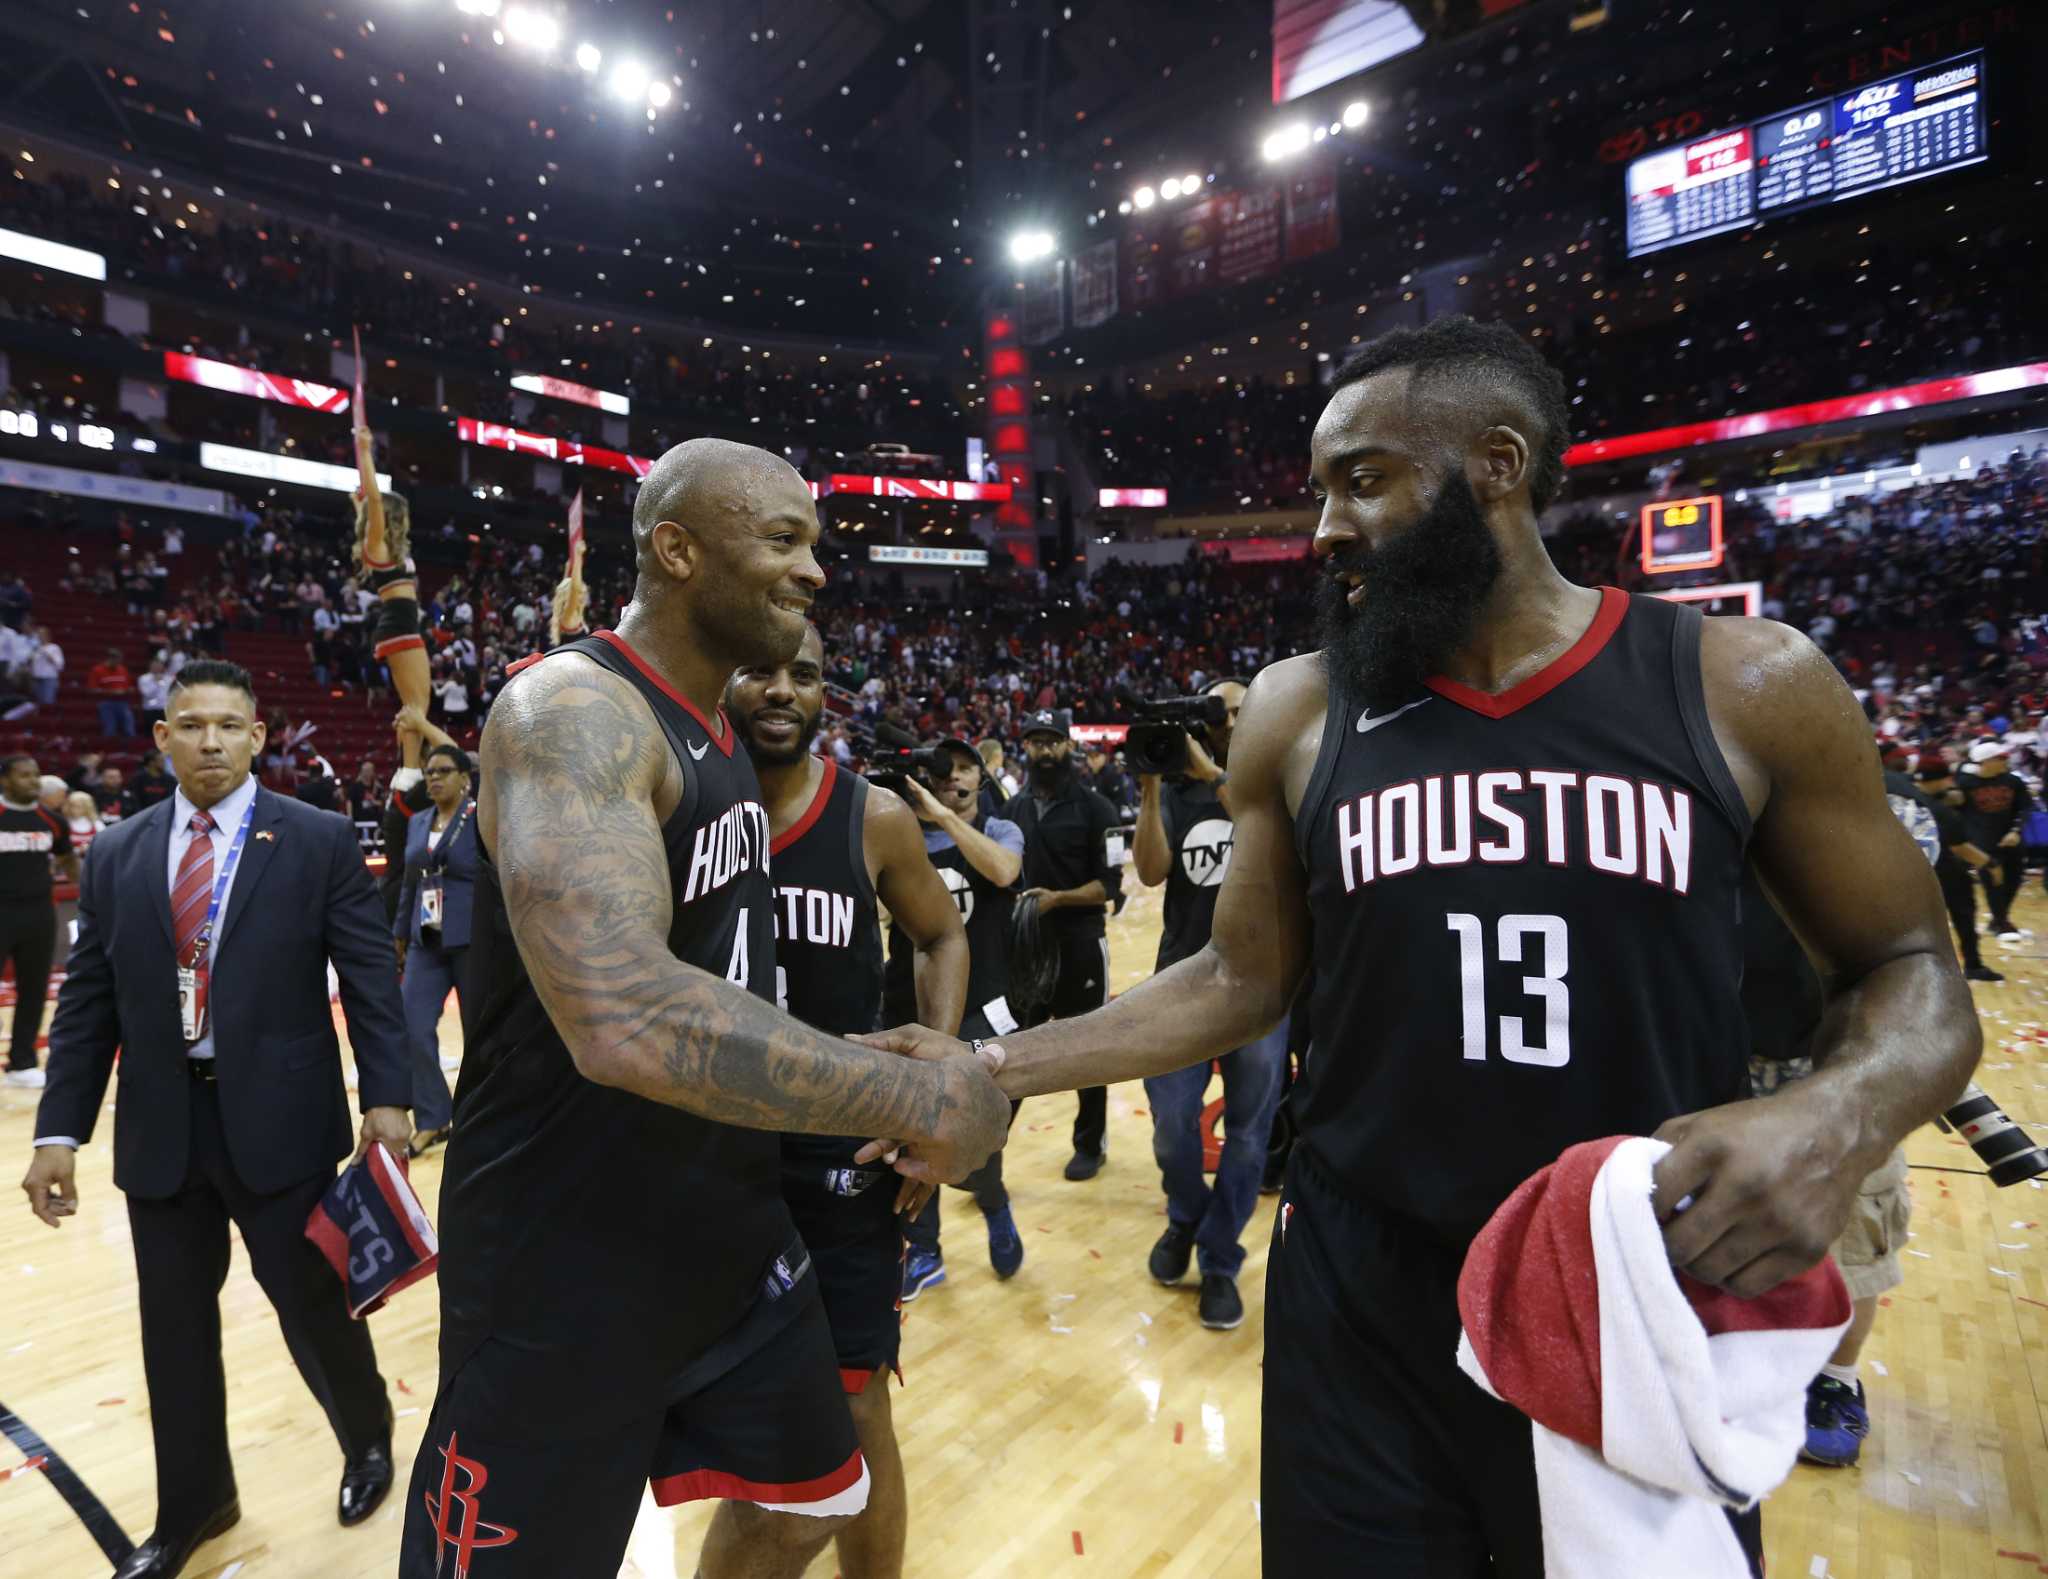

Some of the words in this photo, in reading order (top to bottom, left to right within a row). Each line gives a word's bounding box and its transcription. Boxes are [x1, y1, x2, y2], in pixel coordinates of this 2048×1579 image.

[1852, 102, 1891, 125] 102
[684, 801, 770, 902] HOUSTO
[1337, 769, 1692, 895] HOUSTON
[726, 907, 749, 990] 4
[1446, 912, 1570, 1068] 13
